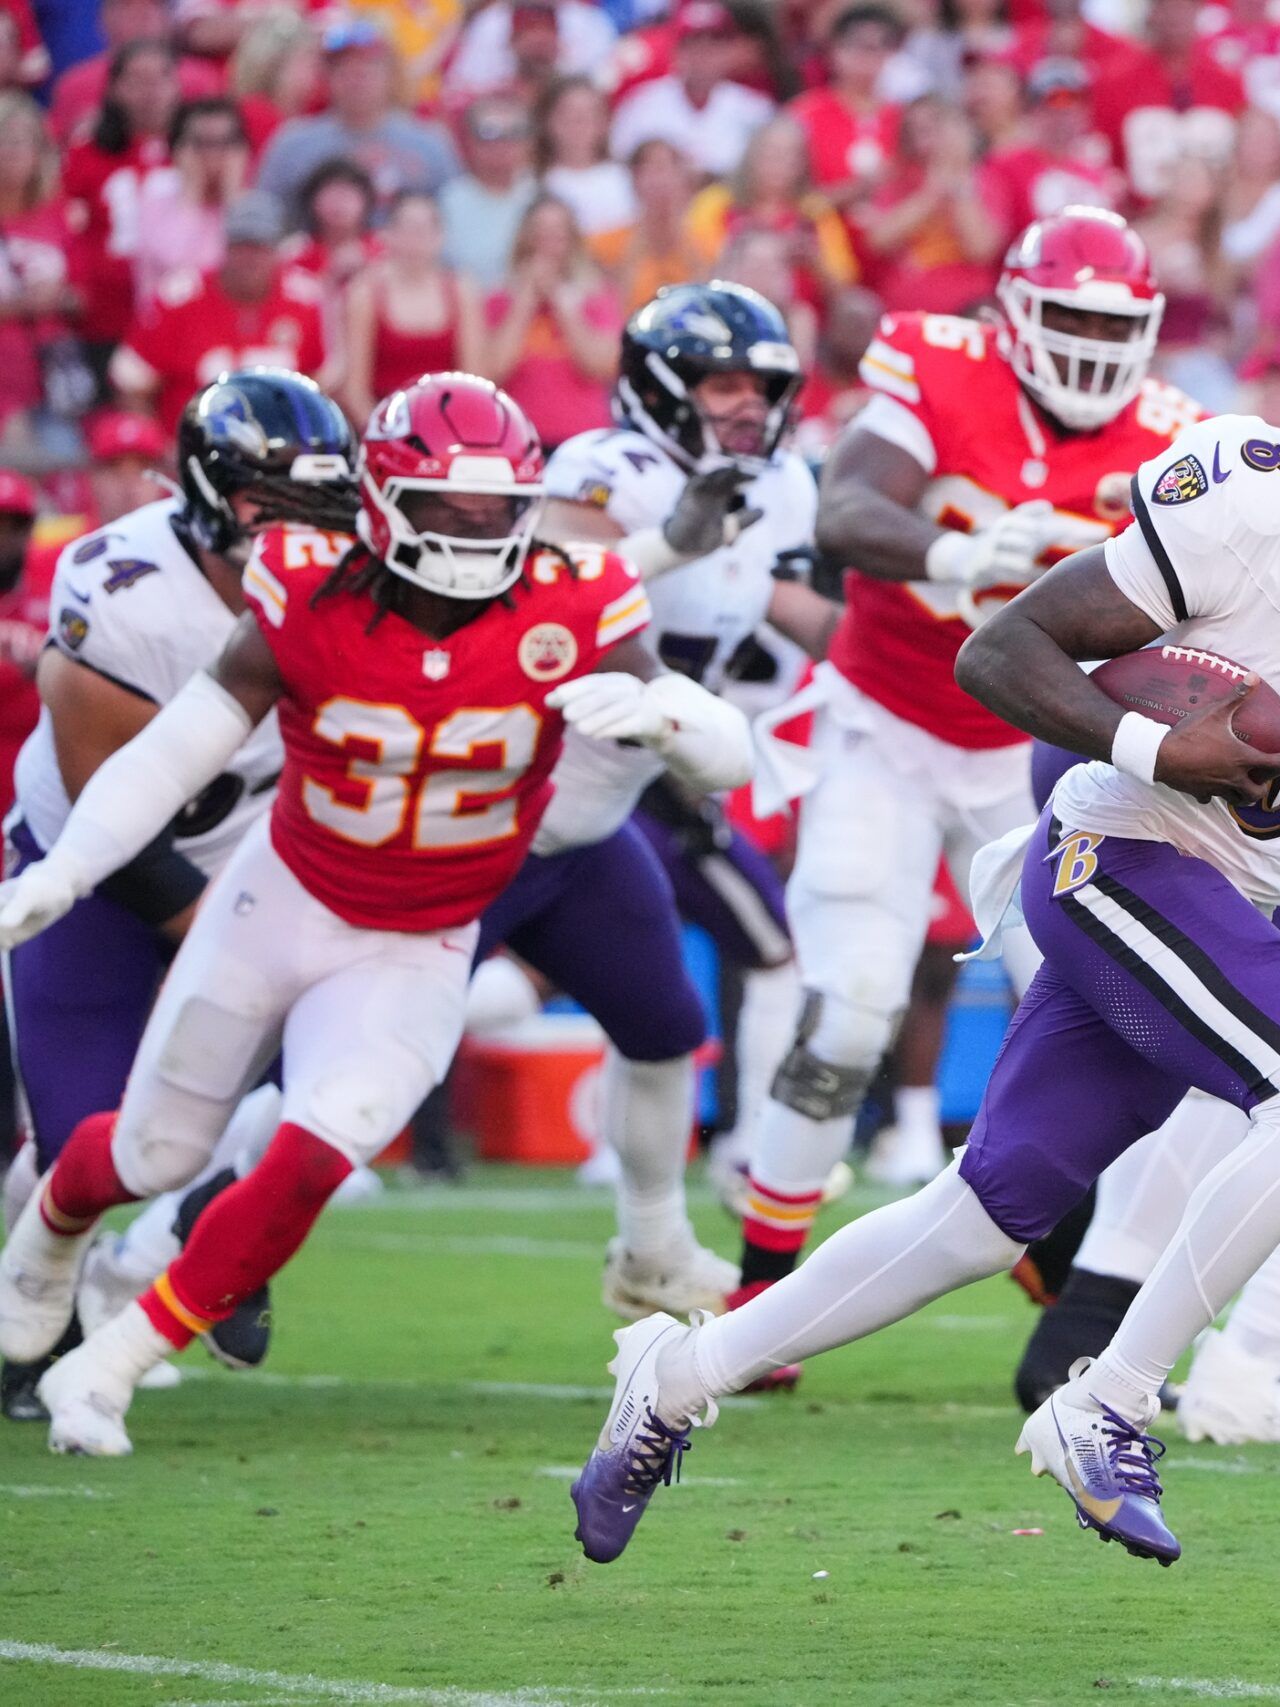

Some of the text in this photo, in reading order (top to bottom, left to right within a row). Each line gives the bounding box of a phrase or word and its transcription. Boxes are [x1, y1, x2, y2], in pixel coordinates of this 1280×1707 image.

[1187, 455, 1207, 490] RAVENS
[1123, 694, 1165, 713] NATIONAL
[1167, 704, 1193, 719] FOOT
[302, 694, 543, 850] 32
[1043, 830, 1105, 897] B
